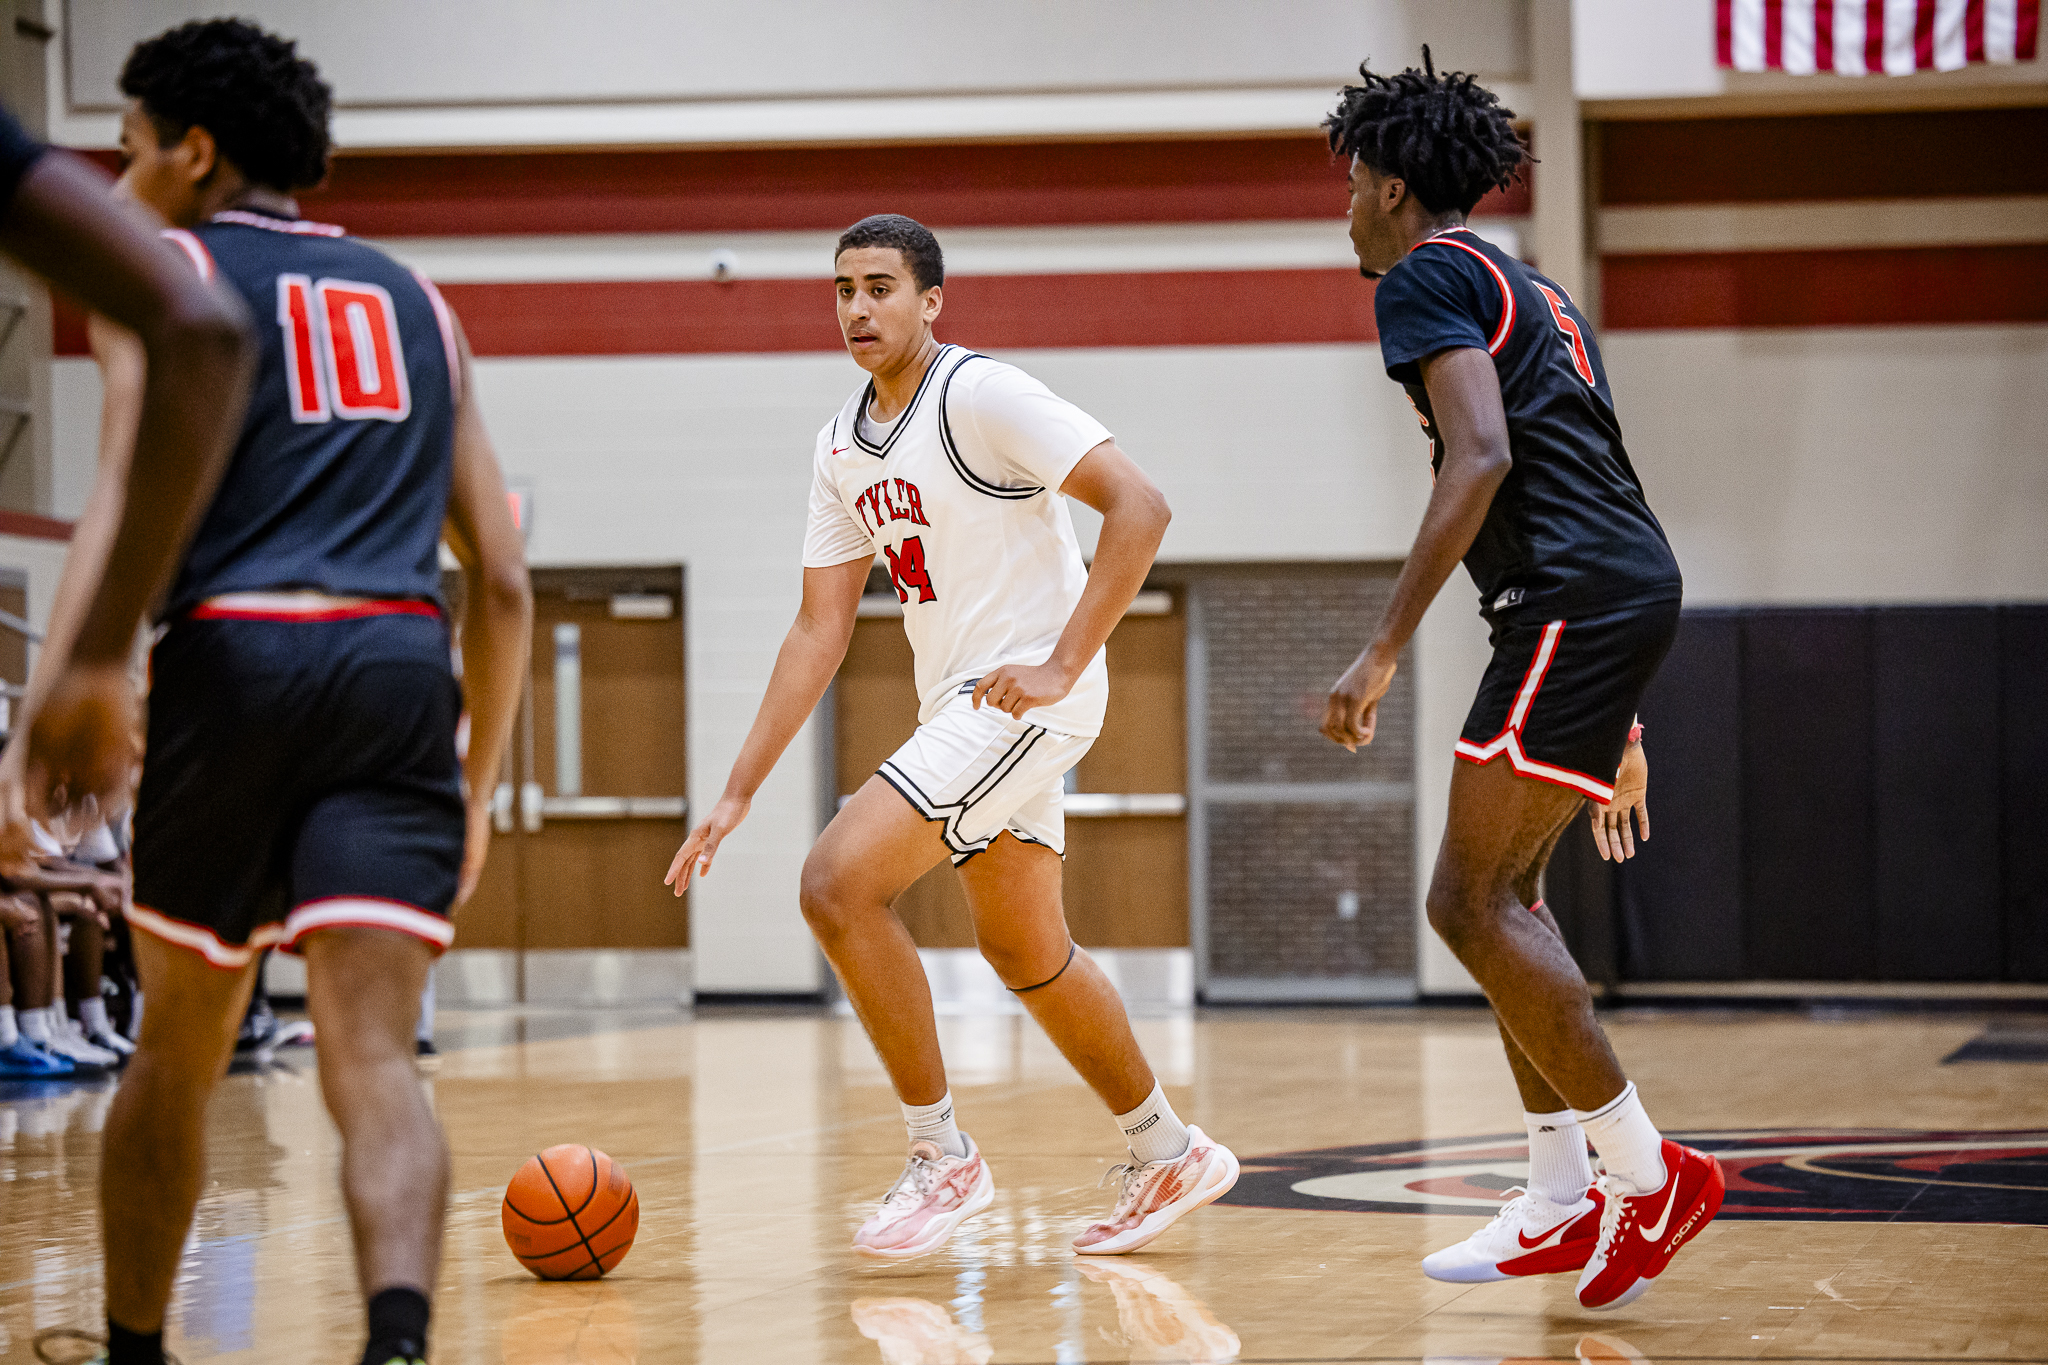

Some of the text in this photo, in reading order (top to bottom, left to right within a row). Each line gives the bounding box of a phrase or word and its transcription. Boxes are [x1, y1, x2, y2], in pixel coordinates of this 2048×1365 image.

[276, 273, 412, 424] 10
[1532, 280, 1596, 388] 5
[855, 477, 931, 538] TYLER
[884, 535, 938, 604] 14
